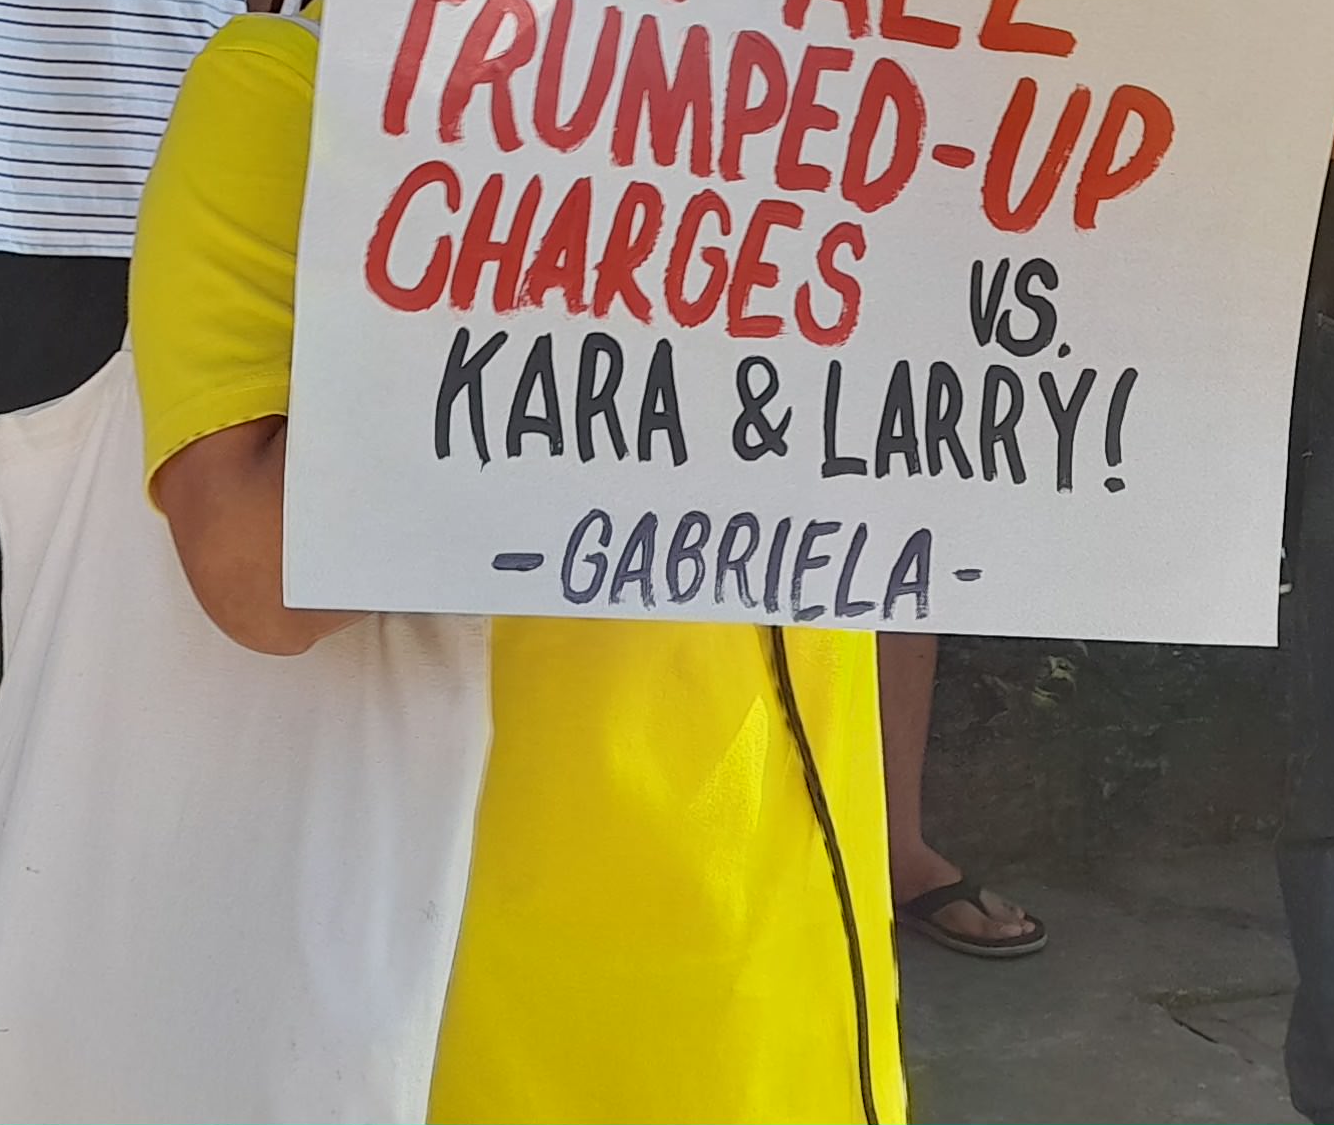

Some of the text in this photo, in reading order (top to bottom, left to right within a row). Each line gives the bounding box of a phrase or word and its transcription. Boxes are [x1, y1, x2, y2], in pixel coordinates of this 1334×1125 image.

[364, 160, 1072, 359] CHARGES VS.
[433, 327, 1139, 493] KARA & LARRY!
